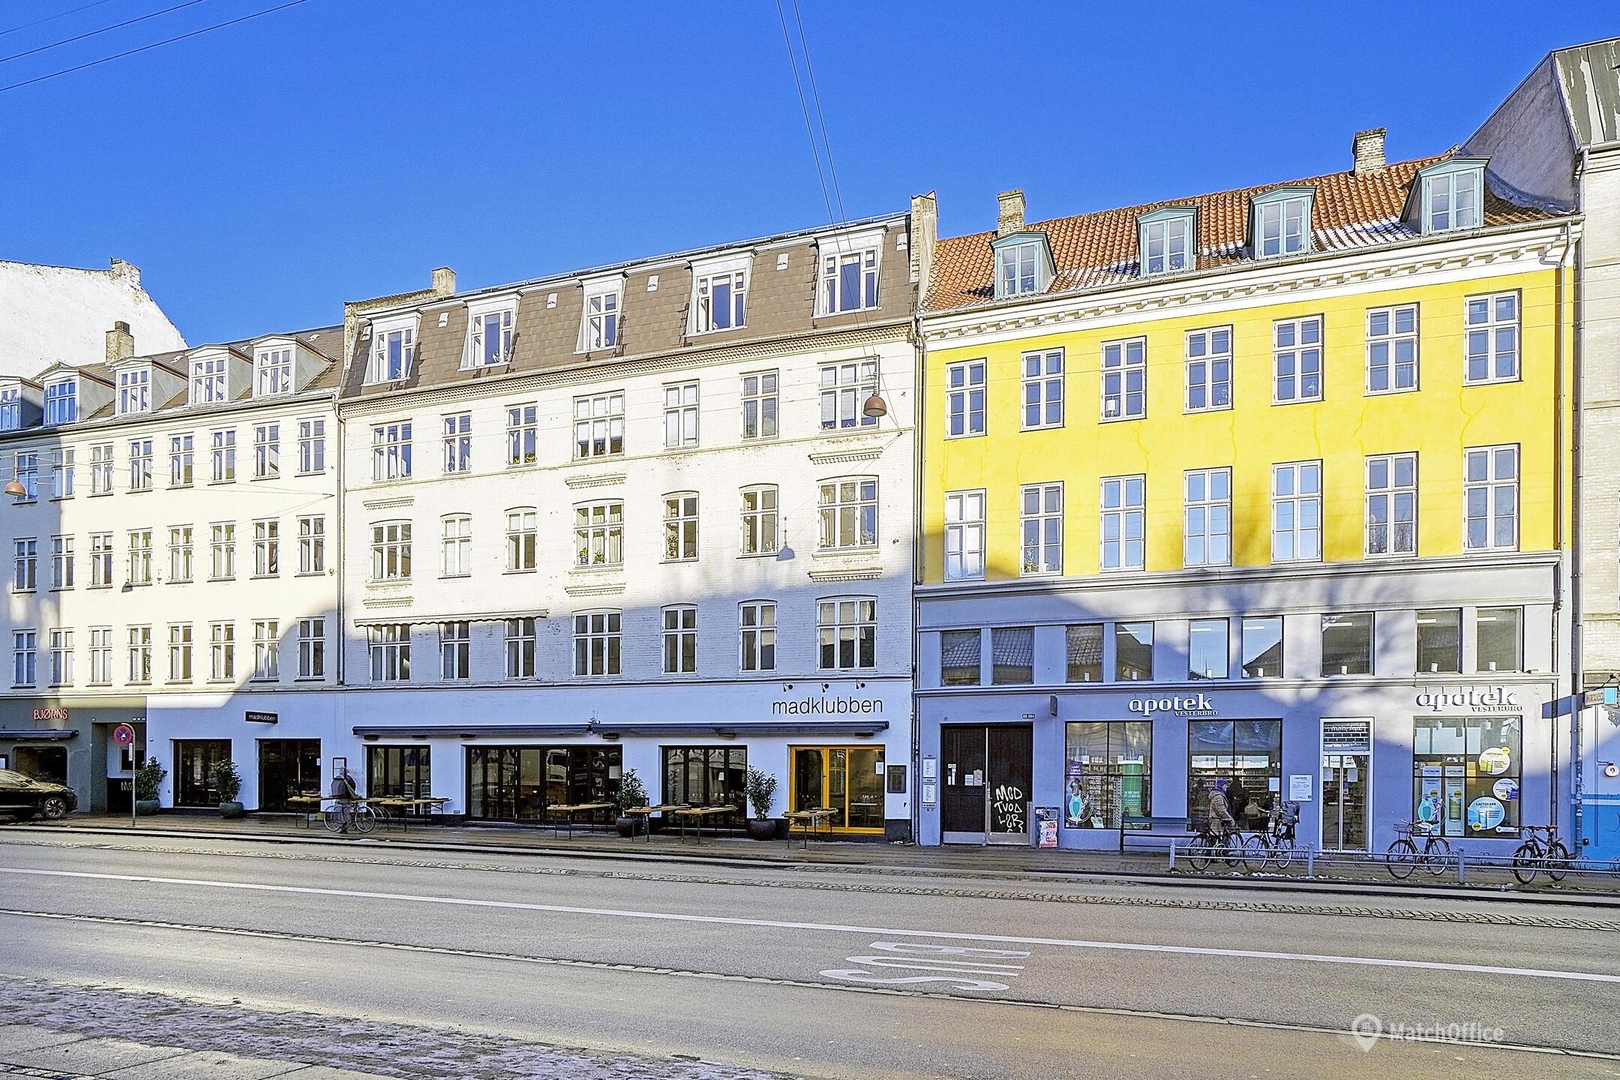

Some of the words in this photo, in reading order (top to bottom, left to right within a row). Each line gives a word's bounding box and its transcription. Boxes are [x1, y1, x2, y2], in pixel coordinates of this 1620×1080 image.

[772, 696, 884, 715] madklubben
[1128, 693, 1213, 717] apotek
[1415, 687, 1518, 712] apotek
[33, 708, 69, 720] BJØRNS
[248, 714, 277, 722] madklubben
